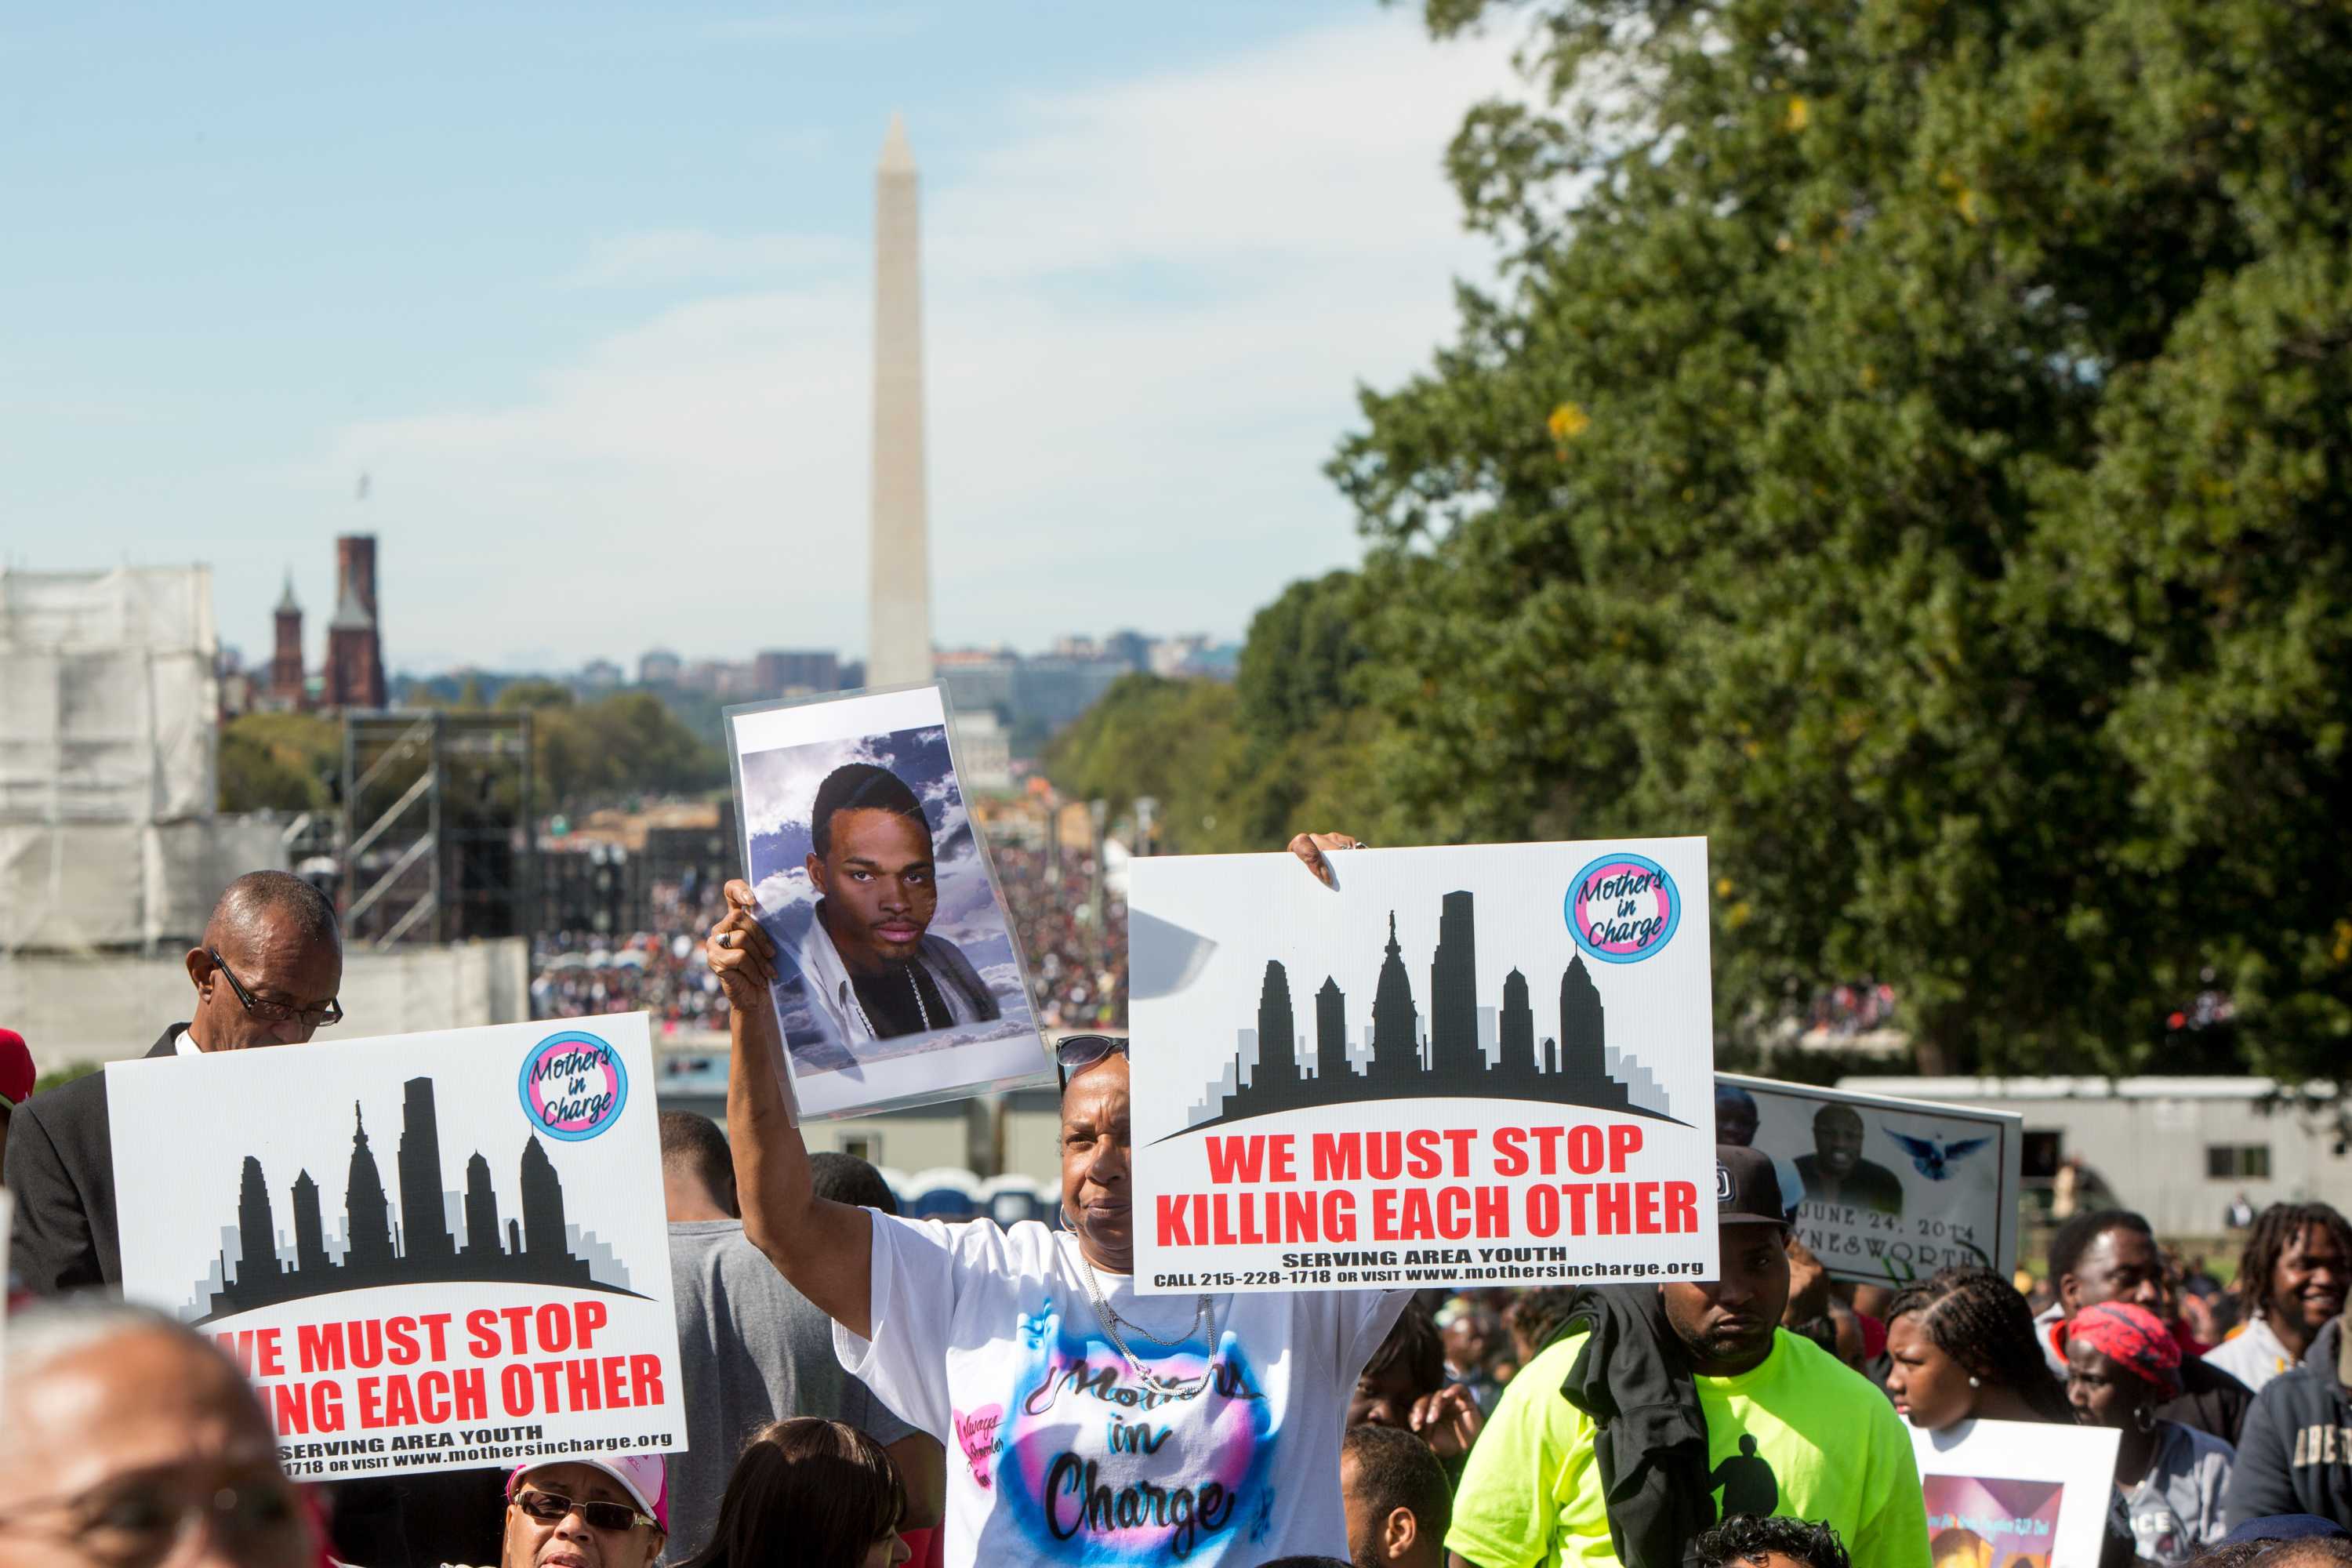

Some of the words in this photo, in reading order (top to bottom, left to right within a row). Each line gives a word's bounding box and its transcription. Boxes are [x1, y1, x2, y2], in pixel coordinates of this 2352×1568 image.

[1578, 869, 1666, 905] Mothers
[1617, 898, 1636, 917] in
[1588, 915, 1663, 948] Charge
[531, 1045, 612, 1084] Mothers
[568, 1076, 586, 1096] in
[543, 1091, 612, 1127] Charge
[1205, 1134, 1297, 1184] WE
[1312, 1129, 1478, 1181] MUST
[1493, 1124, 1643, 1177] STOP
[1156, 1189, 1356, 1247] KILLING
[1373, 1185, 1510, 1241] EACH
[1526, 1181, 1699, 1238] OTHER
[1798, 1202, 1856, 1226] JUNE
[1283, 1250, 1398, 1268] SERVING
[1404, 1248, 1472, 1266] AREA
[1479, 1247, 1566, 1264] YOUTH
[1154, 1273, 1196, 1287] CALL
[1200, 1270, 1331, 1286] 215-228-1718
[1338, 1271, 1358, 1283] OR
[1361, 1270, 1402, 1282] VISIT
[297, 1312, 452, 1374] MUST
[466, 1301, 608, 1359] STOP
[357, 1367, 488, 1429] EACH
[500, 1354, 665, 1417] OTHER
[278, 1438, 384, 1461] SERVING
[391, 1432, 455, 1451] AREA
[459, 1425, 543, 1445] YOUTH
[1112, 1414, 1173, 1454] in
[329, 1461, 349, 1472] OR
[351, 1457, 390, 1471] VISIT
[1045, 1451, 1236, 1559] Charge
